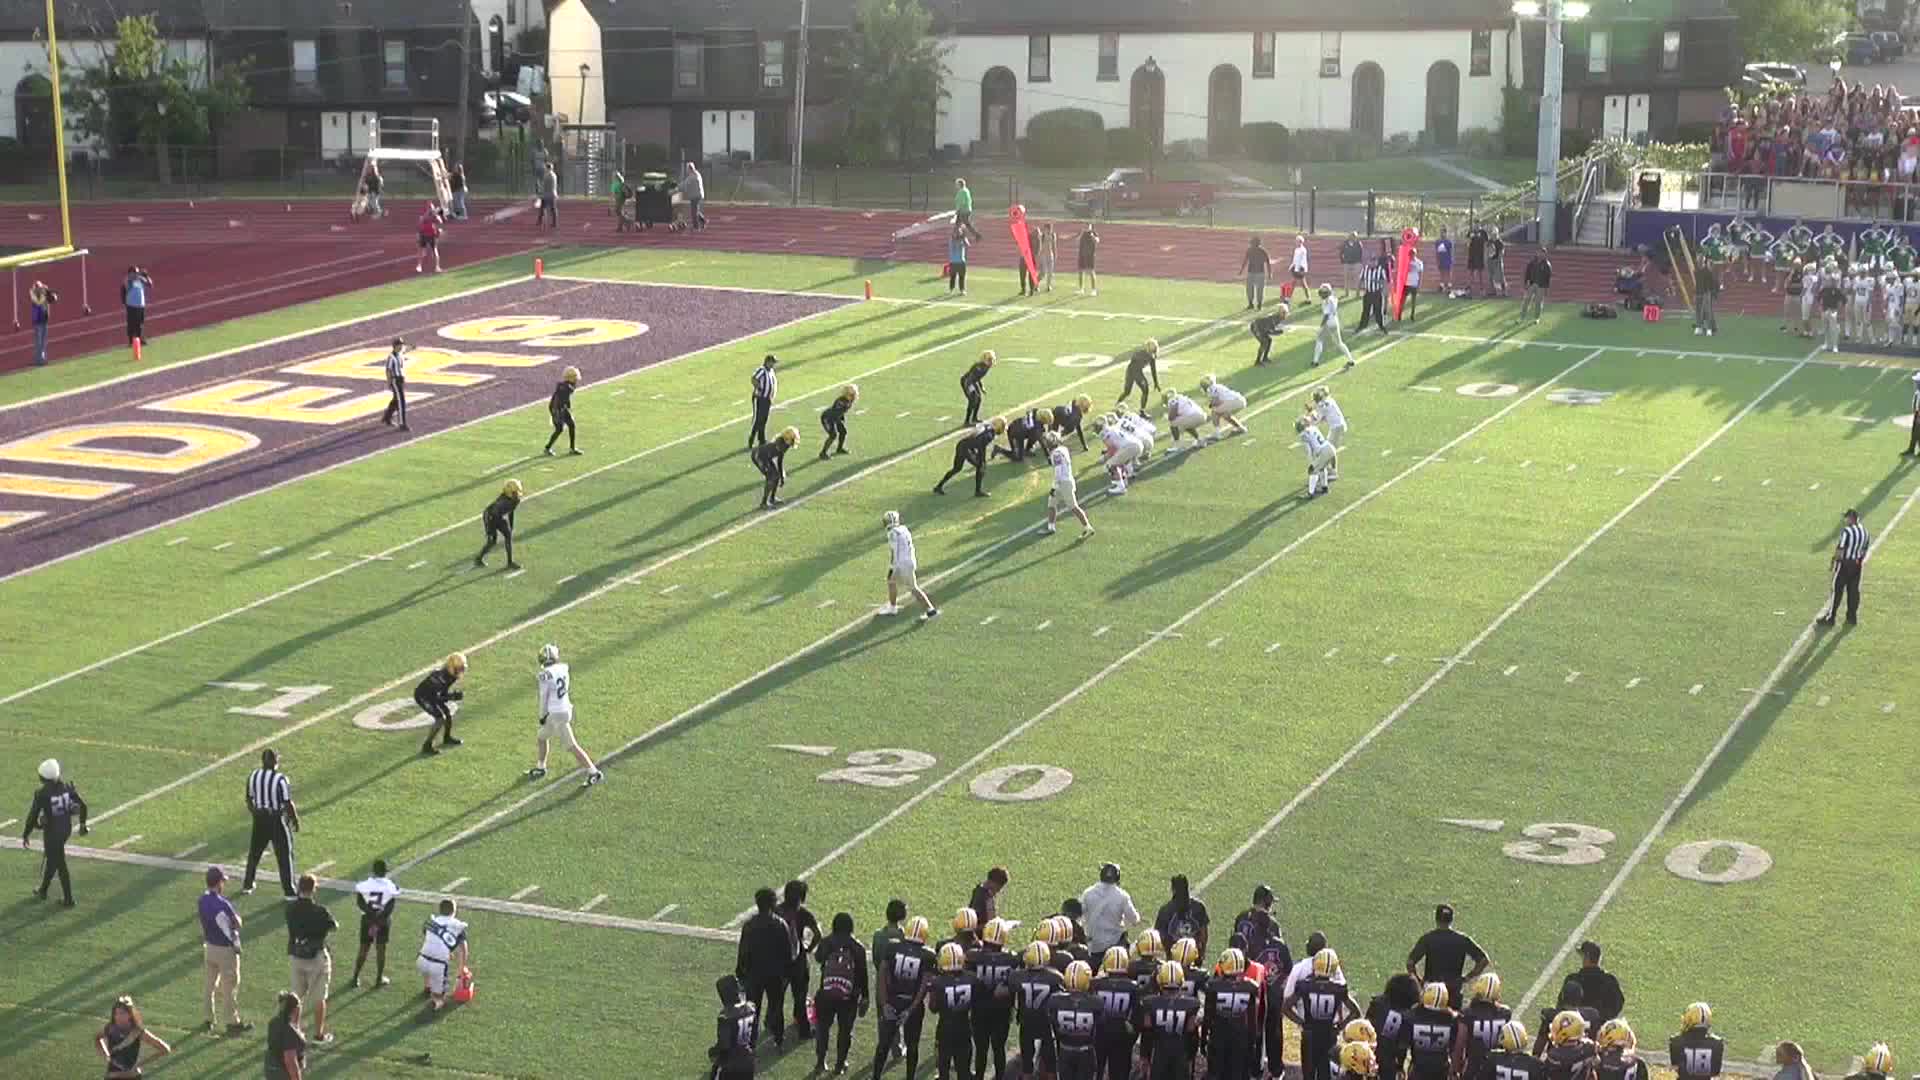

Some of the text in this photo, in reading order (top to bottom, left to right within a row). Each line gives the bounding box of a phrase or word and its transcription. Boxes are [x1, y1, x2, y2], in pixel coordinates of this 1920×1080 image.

[0, 315, 650, 515] IDERS
[816, 748, 1073, 802] 20
[1502, 822, 1775, 883] 30
[1021, 983, 1050, 1010] 17
[1308, 992, 1335, 1019] 10
[1155, 1009, 1187, 1035] 41
